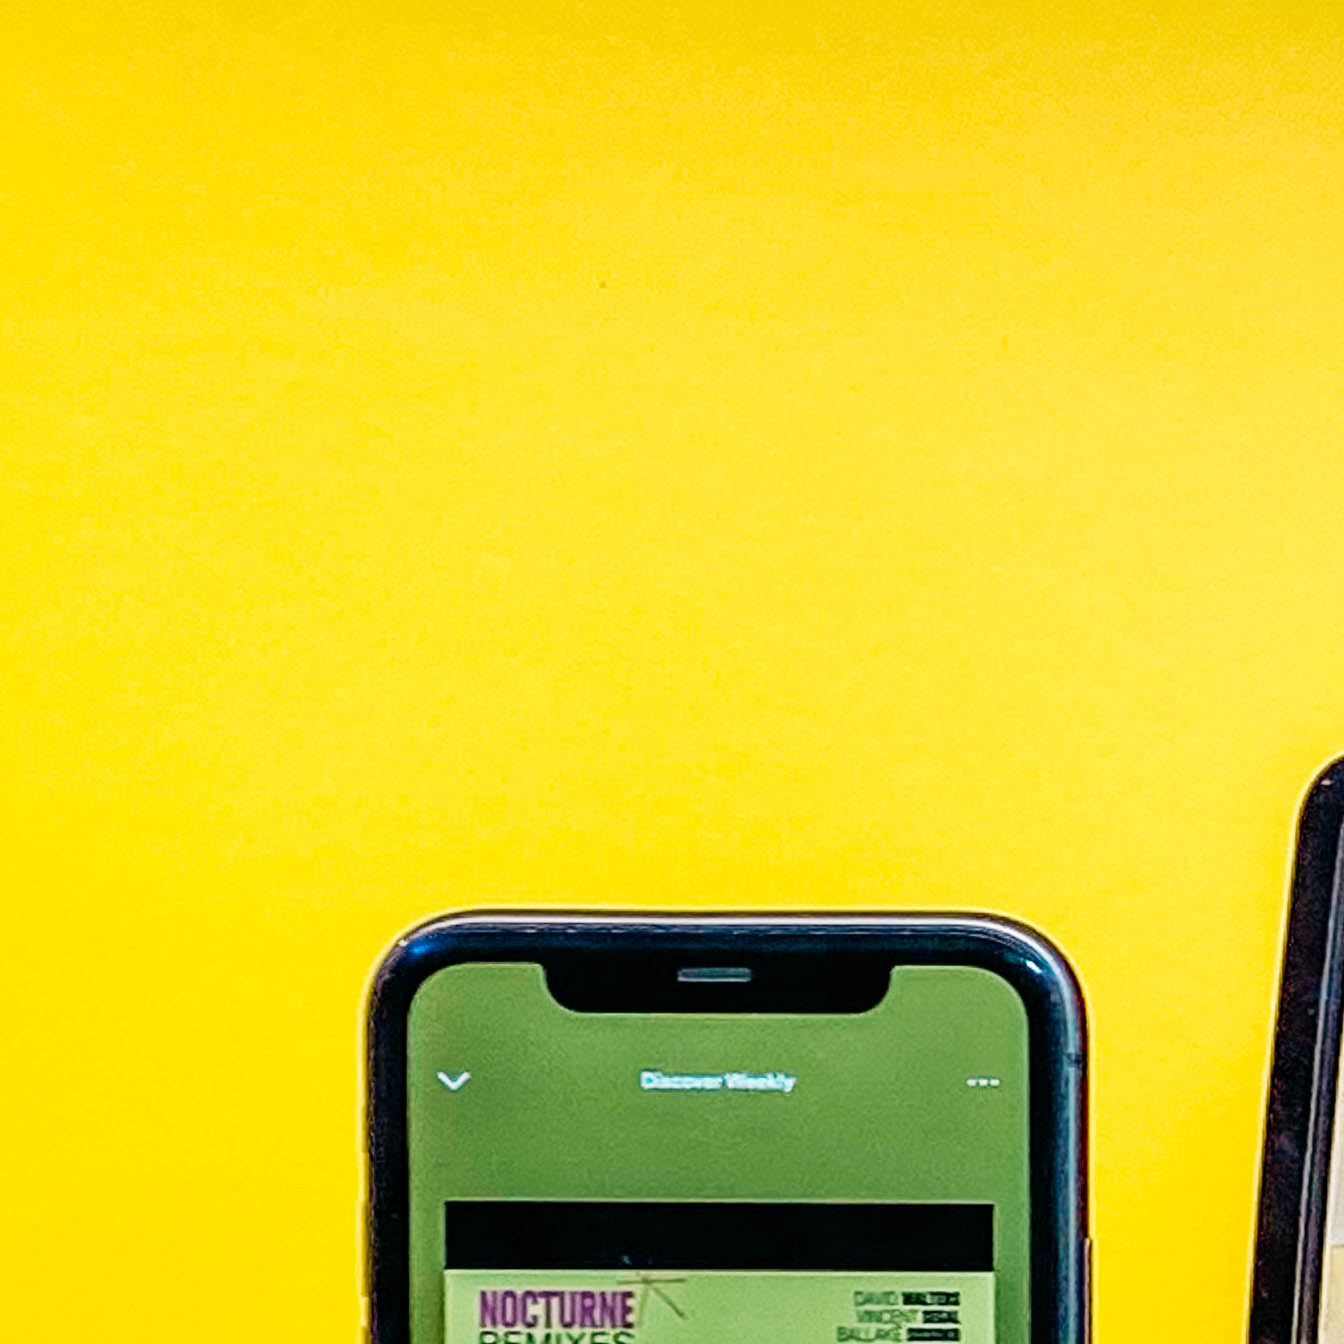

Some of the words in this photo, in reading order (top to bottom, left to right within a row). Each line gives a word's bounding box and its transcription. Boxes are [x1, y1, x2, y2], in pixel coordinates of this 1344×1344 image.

[640, 1071, 723, 1090] Discover
[724, 1072, 797, 1092] Weekly
[480, 1290, 634, 1329] NOCTURNE
